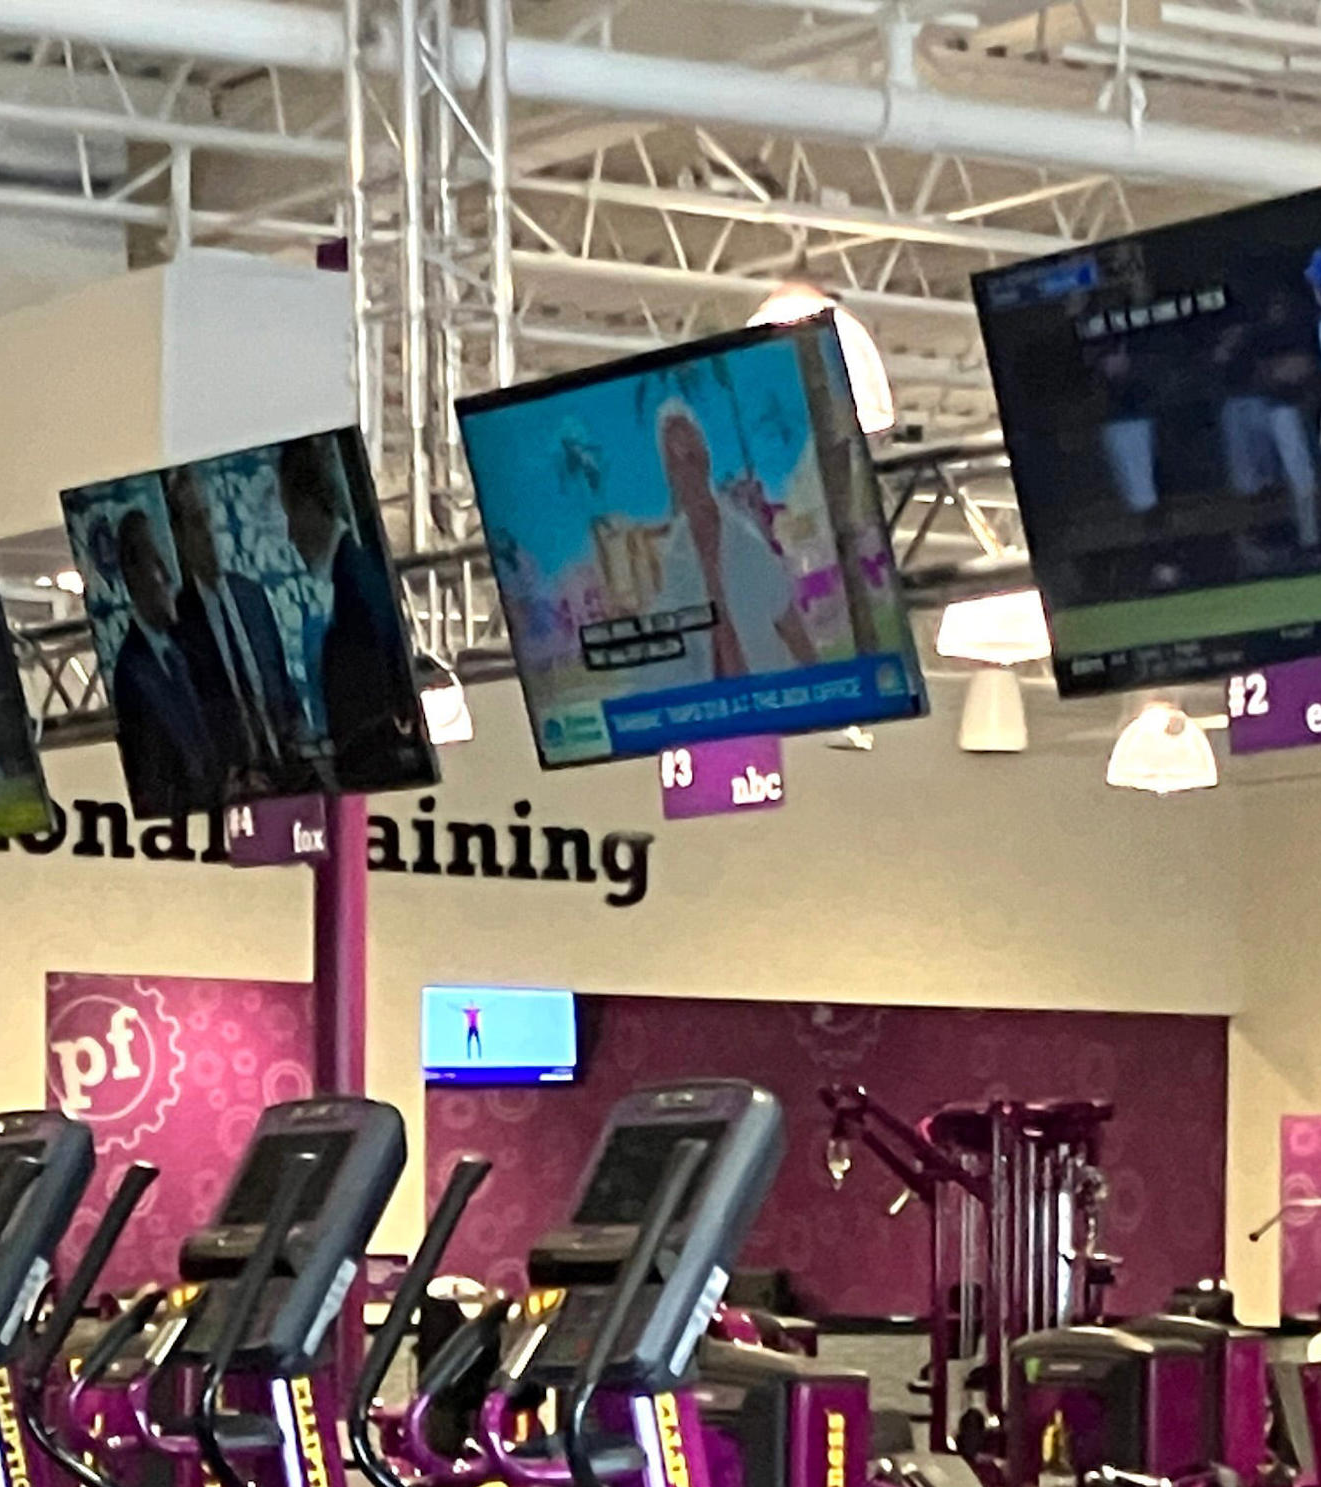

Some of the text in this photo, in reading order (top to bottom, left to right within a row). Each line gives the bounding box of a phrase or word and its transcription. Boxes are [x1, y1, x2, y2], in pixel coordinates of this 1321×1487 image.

[1229, 673, 1269, 717] #2
[731, 767, 782, 806] nbc
[293, 820, 325, 853] fox
[367, 796, 655, 908] aining
[51, 1006, 140, 1110] pf
